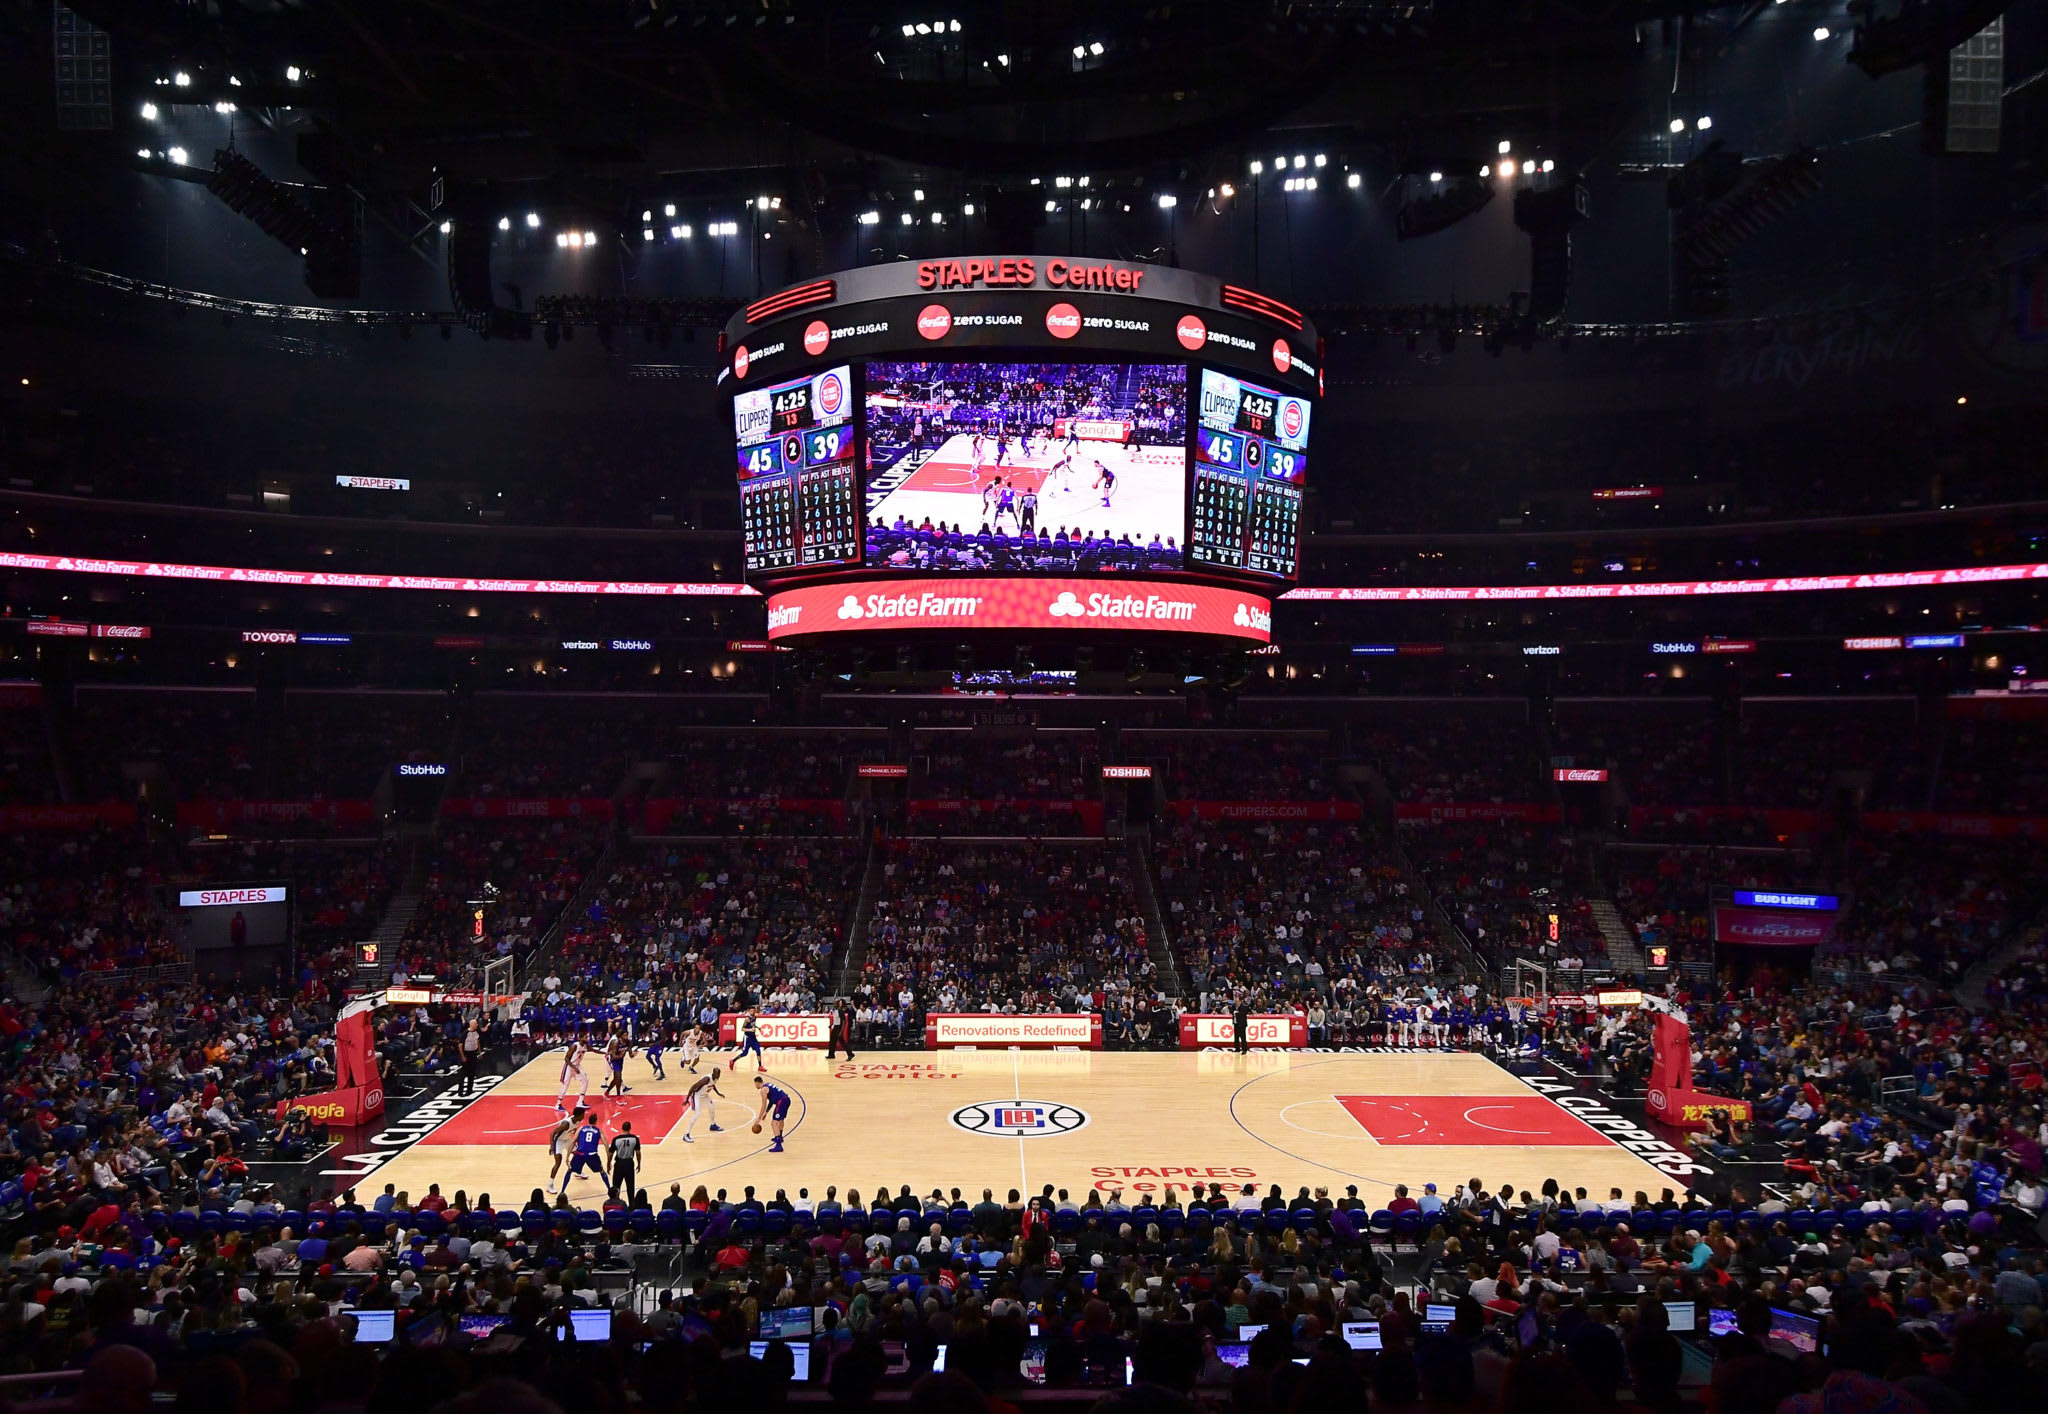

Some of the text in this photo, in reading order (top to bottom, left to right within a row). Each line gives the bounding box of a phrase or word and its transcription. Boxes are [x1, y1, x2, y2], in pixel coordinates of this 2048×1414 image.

[917, 258, 1144, 289] STAPLES Center
[953, 315, 983, 326] zero
[985, 315, 1022, 325] SUGAR
[1083, 316, 1113, 328] zero
[1114, 319, 1149, 331] SUGAR
[831, 326, 855, 340] zero
[856, 322, 888, 335] SUGAR
[1207, 331, 1231, 344] zero
[1231, 338, 1256, 351] SUGAR
[748, 350, 763, 363] zero
[763, 342, 784, 358] SUGAR
[775, 390, 806, 412] 4:25
[1205, 391, 1235, 416] CLIPPERS
[1243, 395, 1273, 417] 4:25
[740, 408, 769, 433] CLIPPERS
[786, 413, 798, 426] 13
[1251, 417, 1262, 430] 13
[1078, 425, 1115, 437] ongfa
[789, 442, 797, 457] 2
[814, 433, 839, 460] 39
[1207, 436, 1233, 463] 45
[1249, 446, 1257, 461] 2
[748, 448, 772, 473] 45
[1271, 452, 1294, 478] 39
[350, 477, 397, 489] STAPLES
[768, 605, 801, 631] tateFarm
[243, 632, 297, 643] TOYOTA
[562, 640, 598, 650] verizon
[612, 640, 651, 650] StubHub
[1844, 638, 1901, 649] TOSHIBA
[1523, 645, 1560, 655] verizon
[1653, 643, 1695, 653] StubHub
[400, 764, 445, 775] StubHub
[1103, 767, 1151, 777] TOSHIBA
[1221, 805, 1308, 818] CLIPPERS.COM
[200, 889, 267, 905] STAPLES
[1754, 893, 1817, 907] BUD LIGHT
[1730, 924, 1821, 938] CLIPPERS
[756, 1021, 818, 1040] ongfa
[942, 1025, 1087, 1036] Renovations Redefined
[1211, 1021, 1278, 1041] Logfa
[834, 1072, 963, 1080] Center
[367, 1092, 381, 1108] KIA
[1652, 1092, 1664, 1107] KIA
[1520, 1076, 1714, 1175] LA CLIPPERS
[585, 1132, 593, 1143] 8
[319, 1149, 399, 1175] LA
[1091, 1167, 1258, 1178] STAPLES
